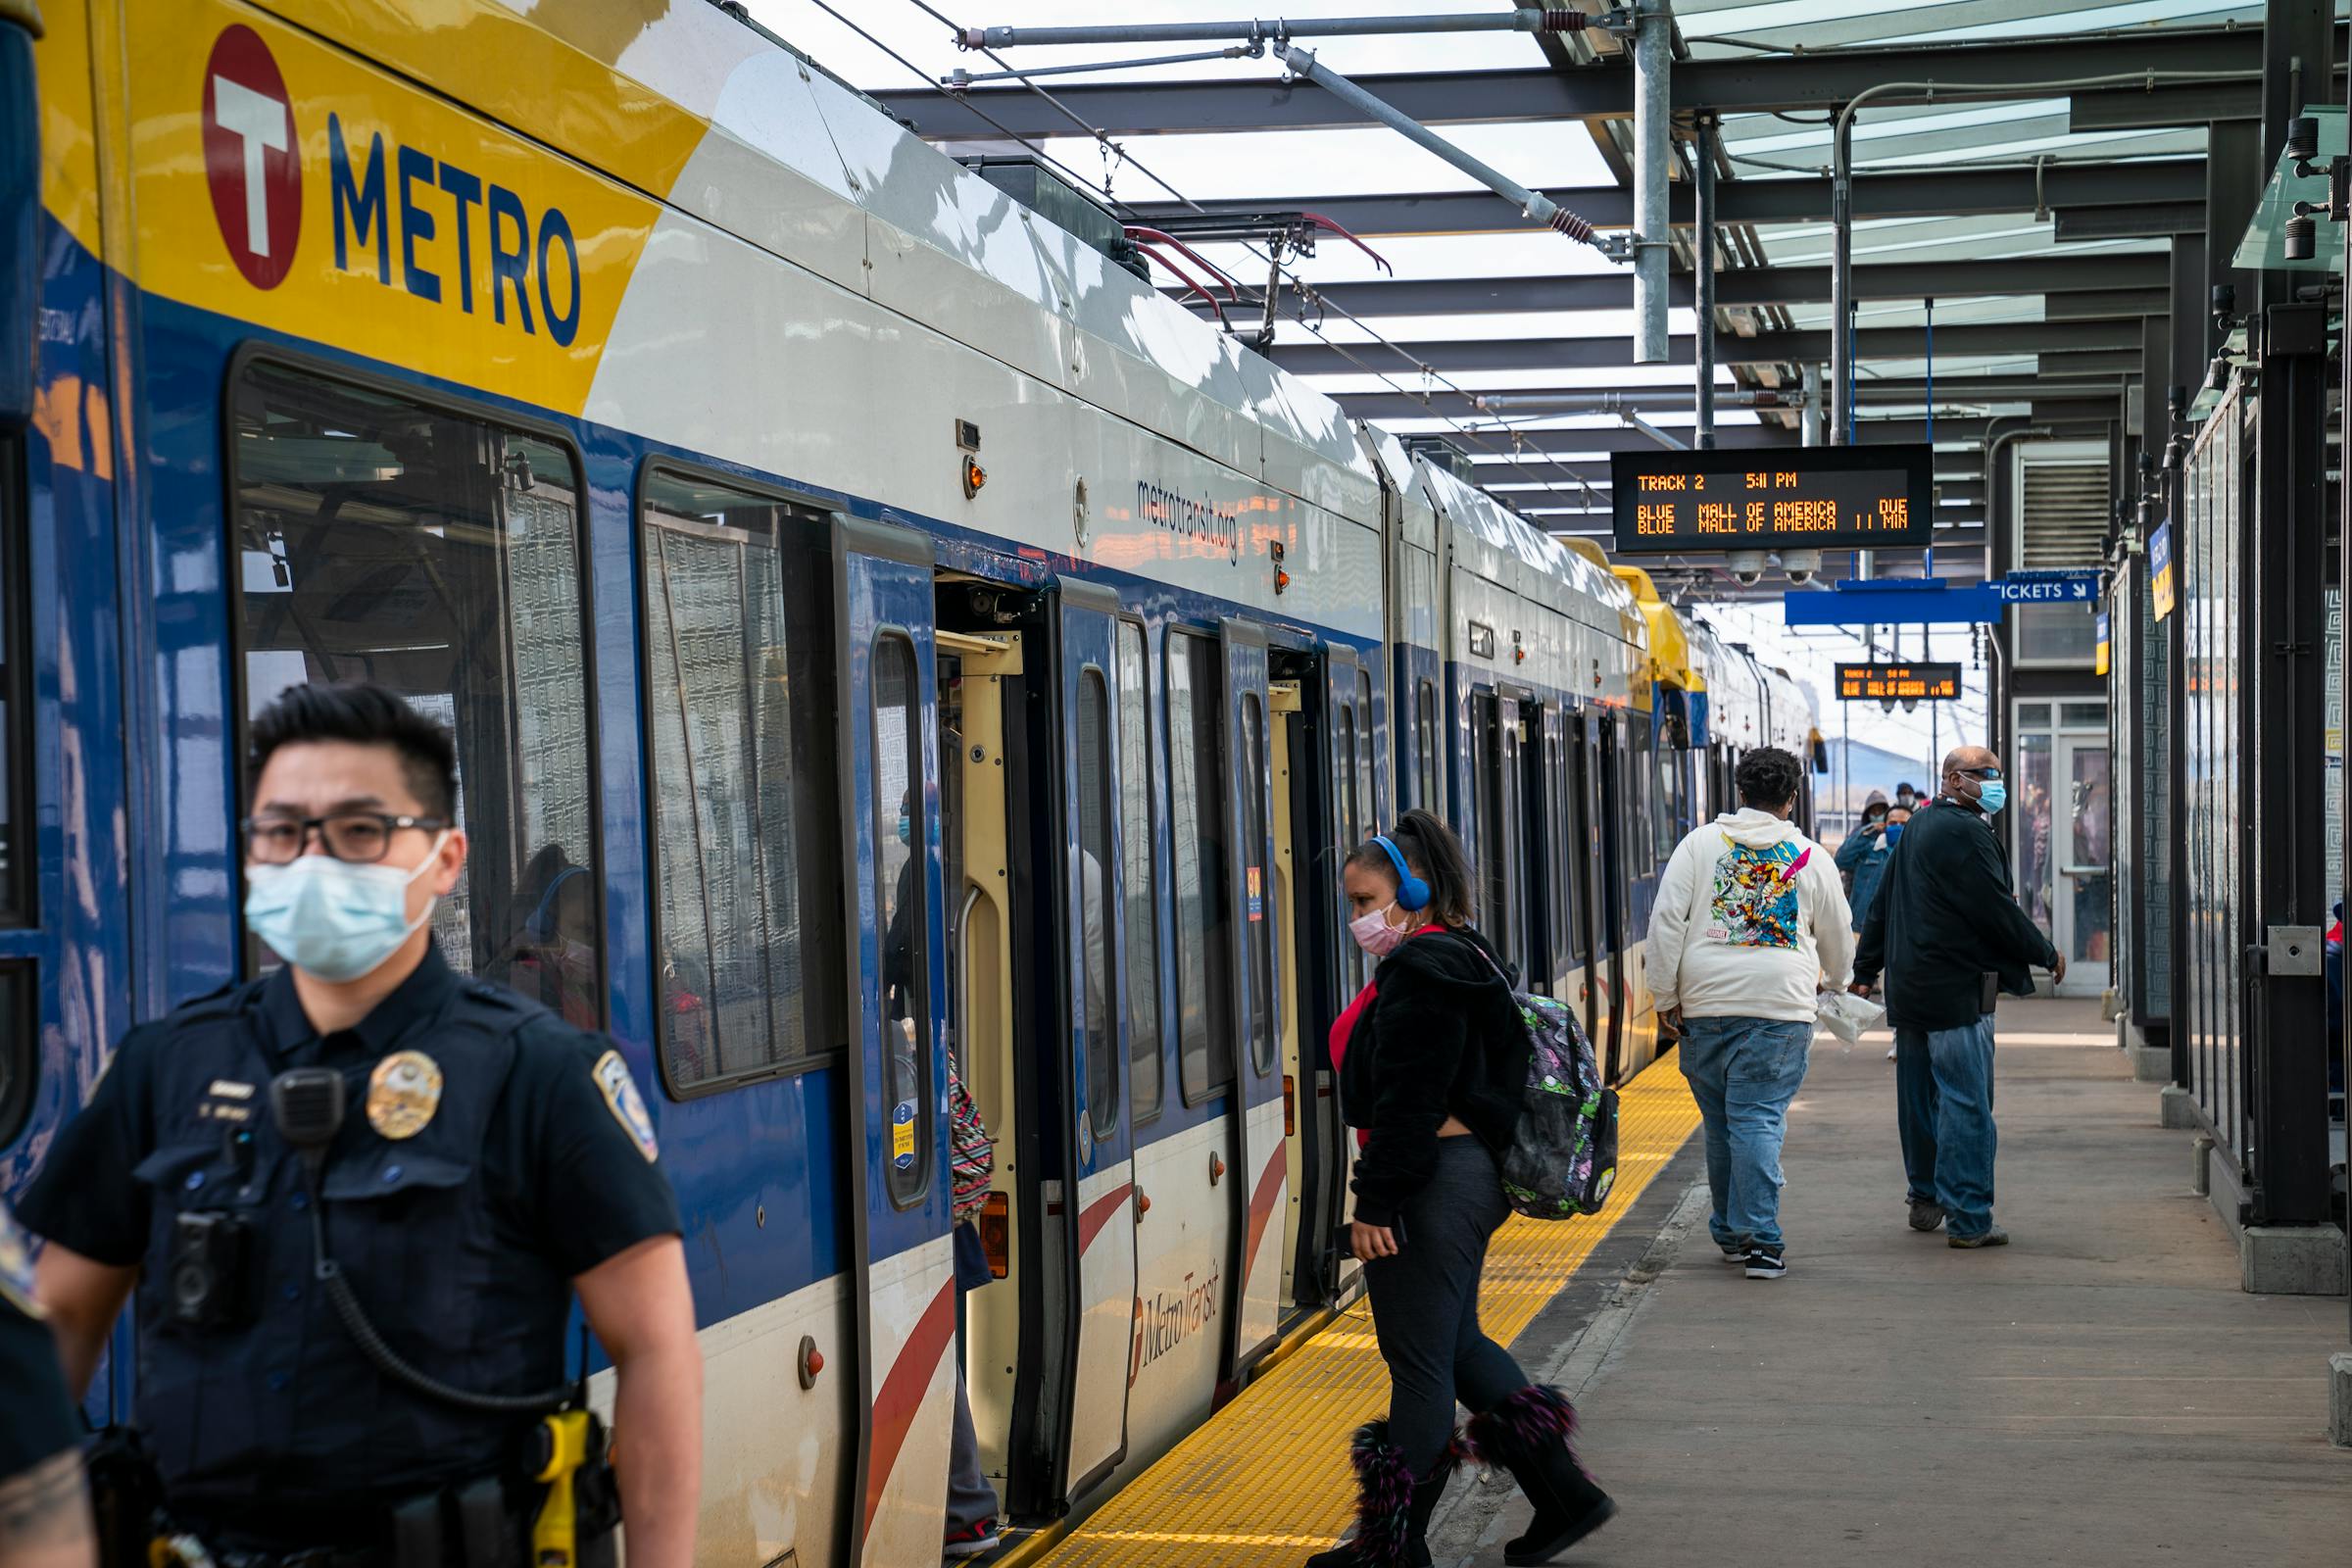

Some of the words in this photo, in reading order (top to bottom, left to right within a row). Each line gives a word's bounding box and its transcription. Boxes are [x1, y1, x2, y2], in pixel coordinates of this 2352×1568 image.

[213, 74, 288, 259] T
[328, 111, 581, 348] METRO
[1638, 474, 1686, 491] TRACK
[1693, 475, 1705, 490] 2
[1745, 472, 1767, 489] 5:11
[1776, 472, 1797, 489] PM
[1638, 504, 1675, 519] BLUE
[1698, 503, 1738, 518] MALL
[1746, 502, 1765, 517] OF
[1774, 501, 1837, 516] AMERICA
[1879, 499, 1908, 514] DUE
[1137, 477, 1238, 567] metrotransit.org
[1638, 518, 1675, 534] BLUE
[1698, 517, 1738, 533] MALL
[1746, 517, 1765, 532] OF
[1774, 515, 1837, 531] AMERICA
[1883, 514, 1908, 529] MIN
